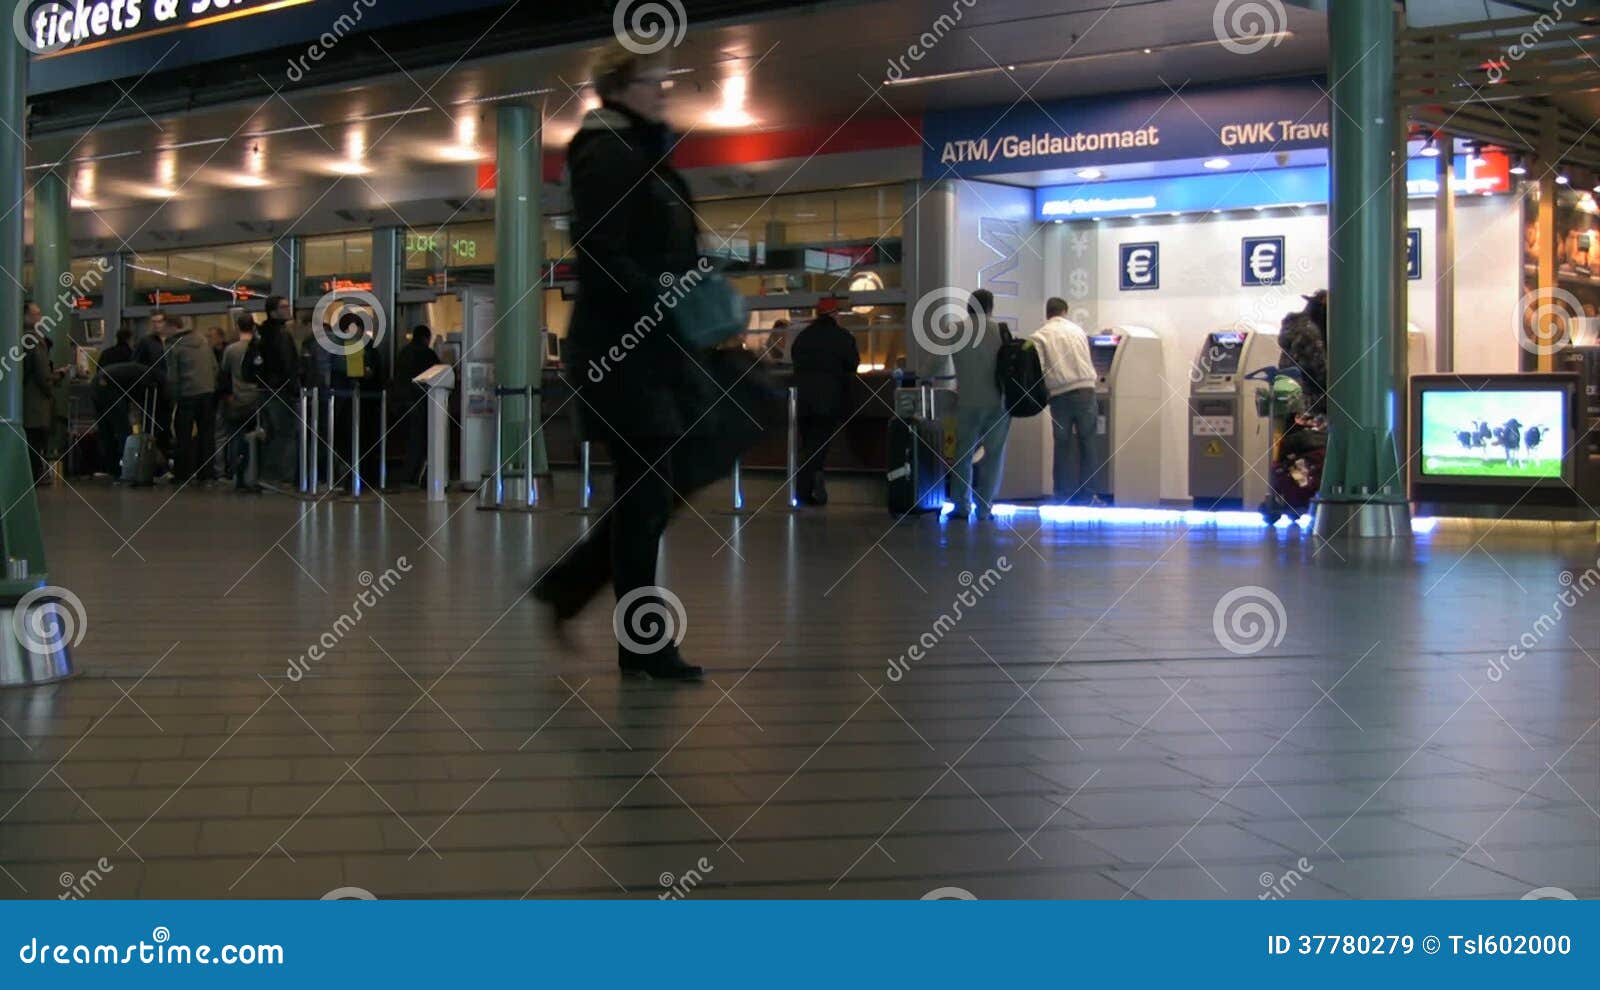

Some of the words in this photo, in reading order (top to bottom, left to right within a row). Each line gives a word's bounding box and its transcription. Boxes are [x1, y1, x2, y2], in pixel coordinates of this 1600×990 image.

[35, 0, 140, 48] tickets
[941, 126, 1159, 164] ATM/Geldautomaat
[1221, 121, 1276, 146] GWK
